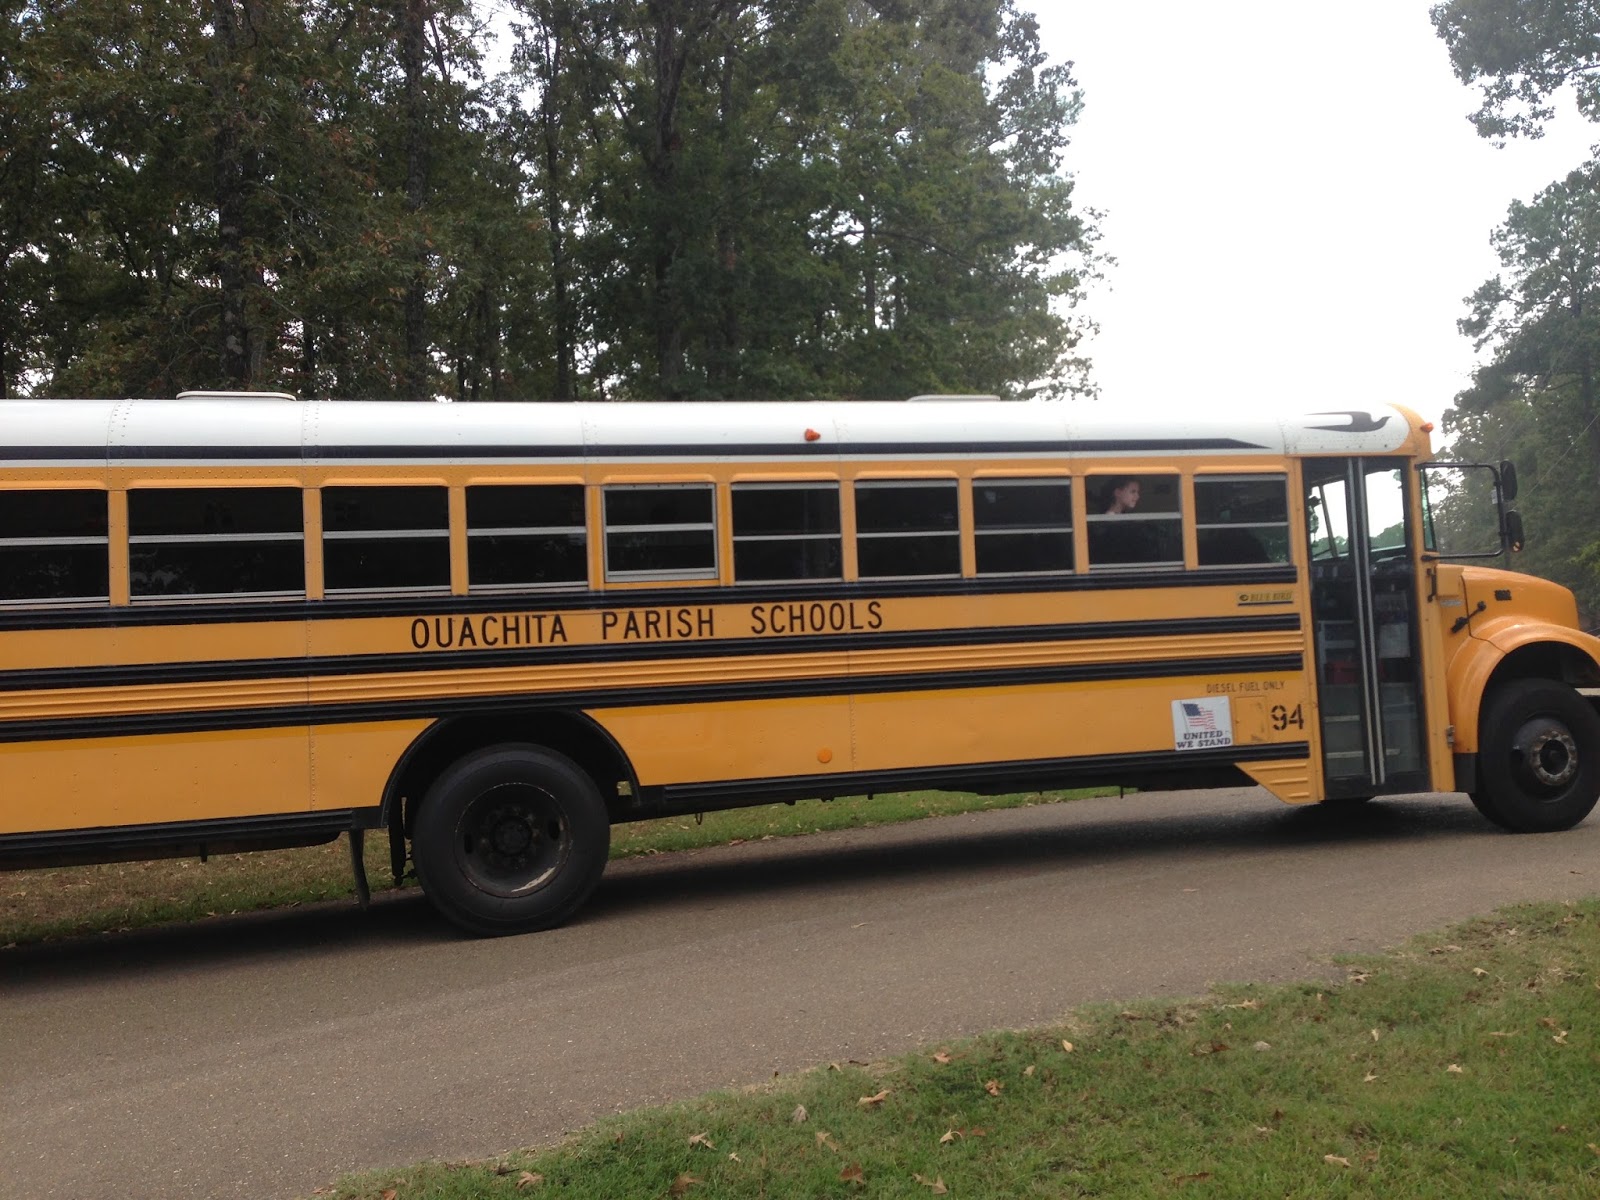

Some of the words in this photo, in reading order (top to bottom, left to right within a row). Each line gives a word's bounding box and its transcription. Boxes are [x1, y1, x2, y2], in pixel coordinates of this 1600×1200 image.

[411, 614, 568, 649] OUACHITA
[602, 607, 714, 640] PARISH
[751, 600, 883, 634] SCHOOLS
[1206, 682, 1236, 693] DIESEL
[1239, 681, 1260, 691] FUEL
[1263, 680, 1285, 690] ONLY
[1271, 703, 1304, 731] 94
[1183, 730, 1223, 740] UNITED
[1176, 741, 1194, 749] WE
[1197, 738, 1231, 747] STAND
